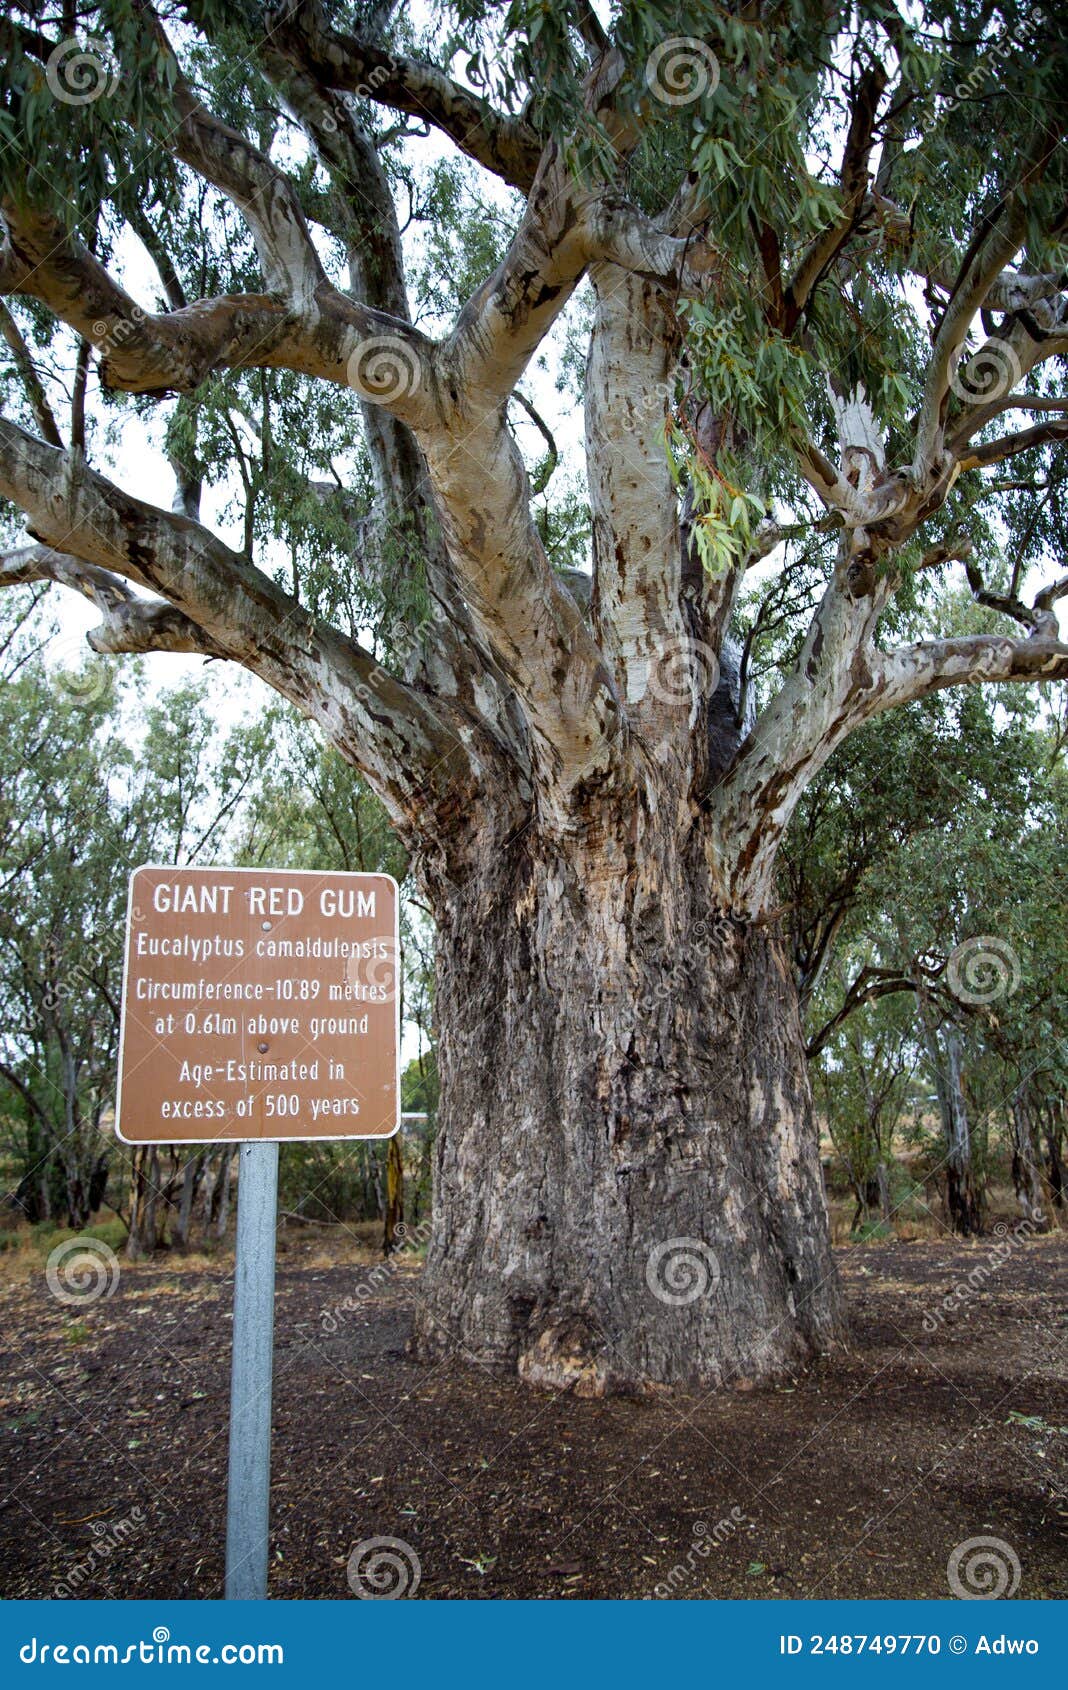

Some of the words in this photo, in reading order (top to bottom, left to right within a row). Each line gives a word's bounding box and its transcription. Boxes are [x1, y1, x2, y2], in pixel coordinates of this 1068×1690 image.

[154, 884, 234, 914] GIANT
[249, 887, 304, 916] RED
[320, 889, 376, 918] GUM
[137, 933, 244, 961] Eucalyptus
[256, 937, 388, 960] camaldulensis
[329, 981, 387, 1000] metres
[155, 1014, 174, 1035] at
[185, 1014, 236, 1034] 0.61m
[248, 1015, 299, 1035] above
[310, 1014, 368, 1041] ground
[179, 1060, 319, 1088] Age-Estimated
[329, 1060, 344, 1080] in
[161, 1100, 225, 1118] excess
[237, 1096, 254, 1117] of
[265, 1095, 300, 1117] 500
[311, 1097, 360, 1120] years
